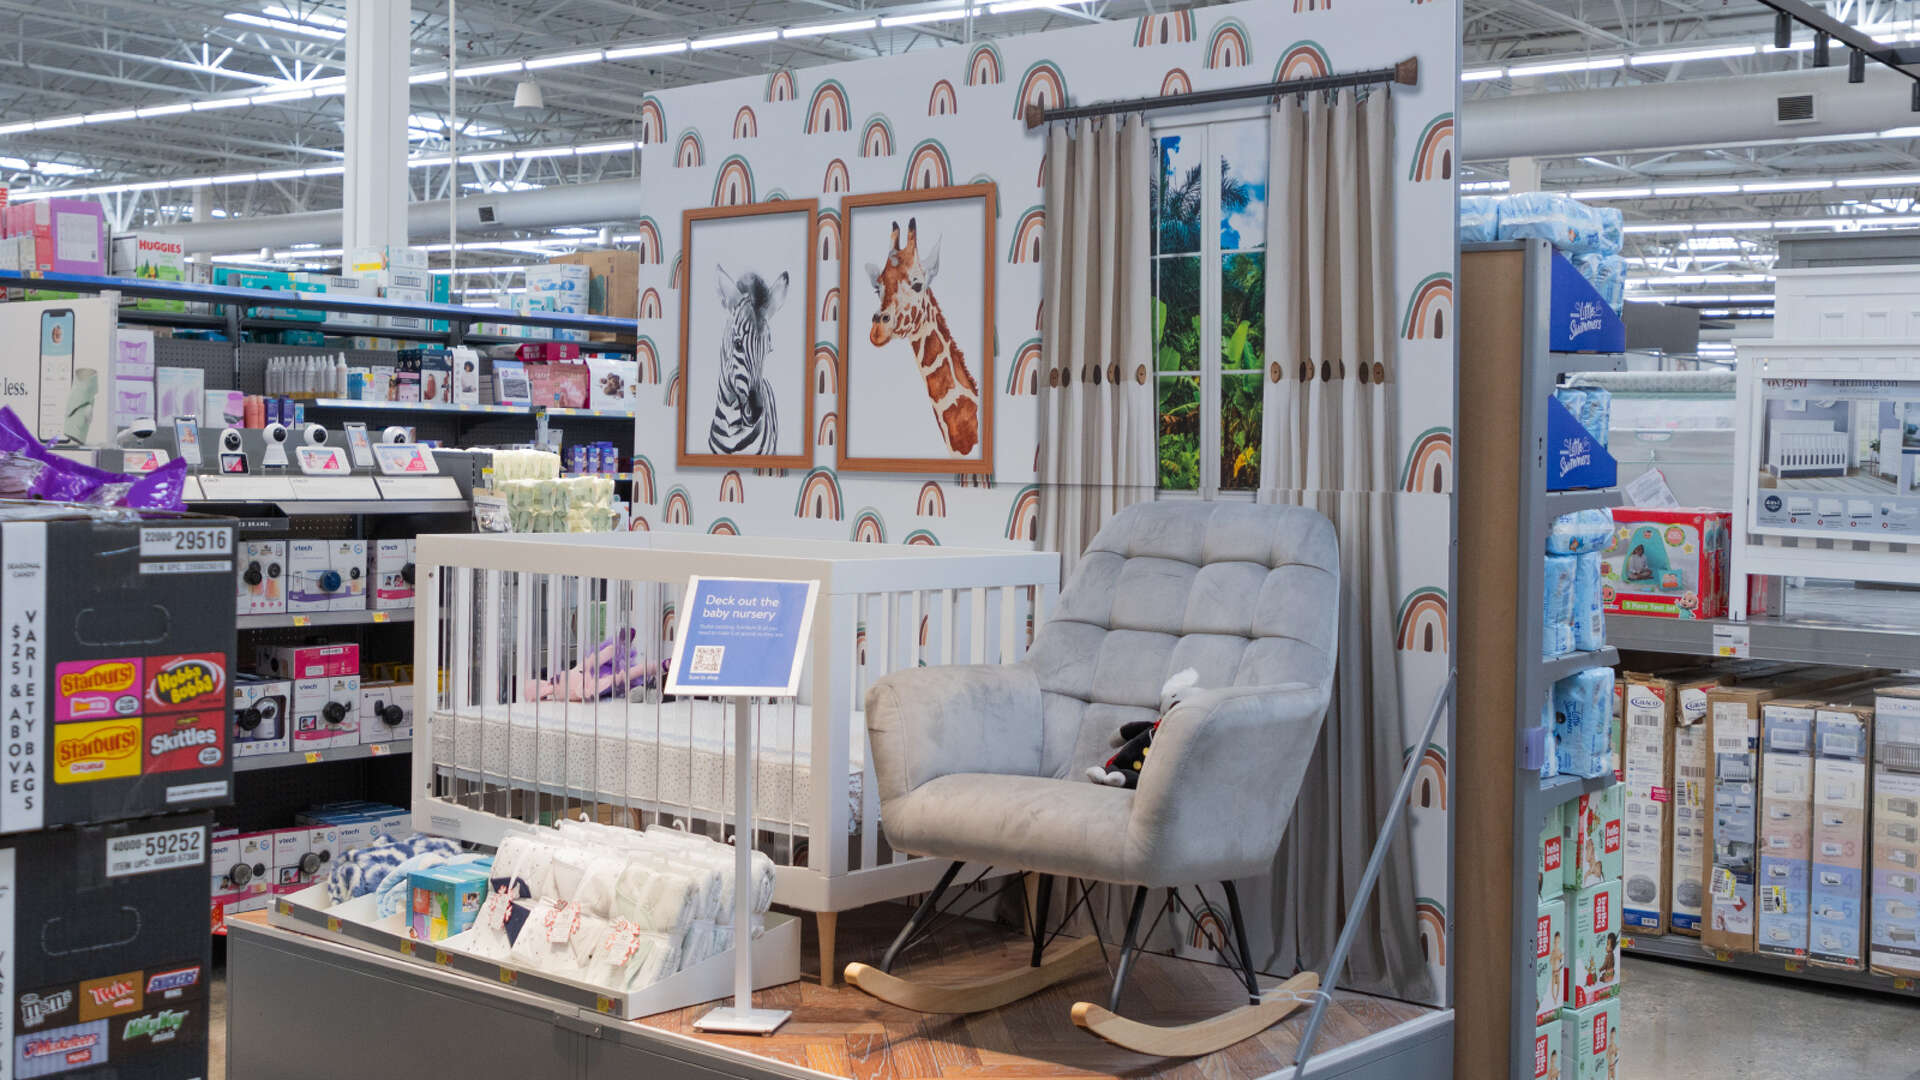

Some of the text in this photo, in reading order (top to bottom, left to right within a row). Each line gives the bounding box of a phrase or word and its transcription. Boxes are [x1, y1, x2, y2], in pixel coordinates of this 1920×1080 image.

[139, 239, 182, 254] HUGGIES
[1578, 301, 1597, 320] Little
[3, 377, 28, 396] less.
[703, 608, 776, 622] baby nursery
[706, 594, 780, 608] Deck out the
[61, 664, 135, 694] Starburst
[156, 666, 203, 694] Hubba
[170, 673, 214, 704] Bubba
[9, 624, 22, 793] $25 & ABOVE
[23, 610, 37, 810] VARIETY BAGS
[60, 729, 137, 762] Starburst
[150, 727, 217, 756] Skittles
